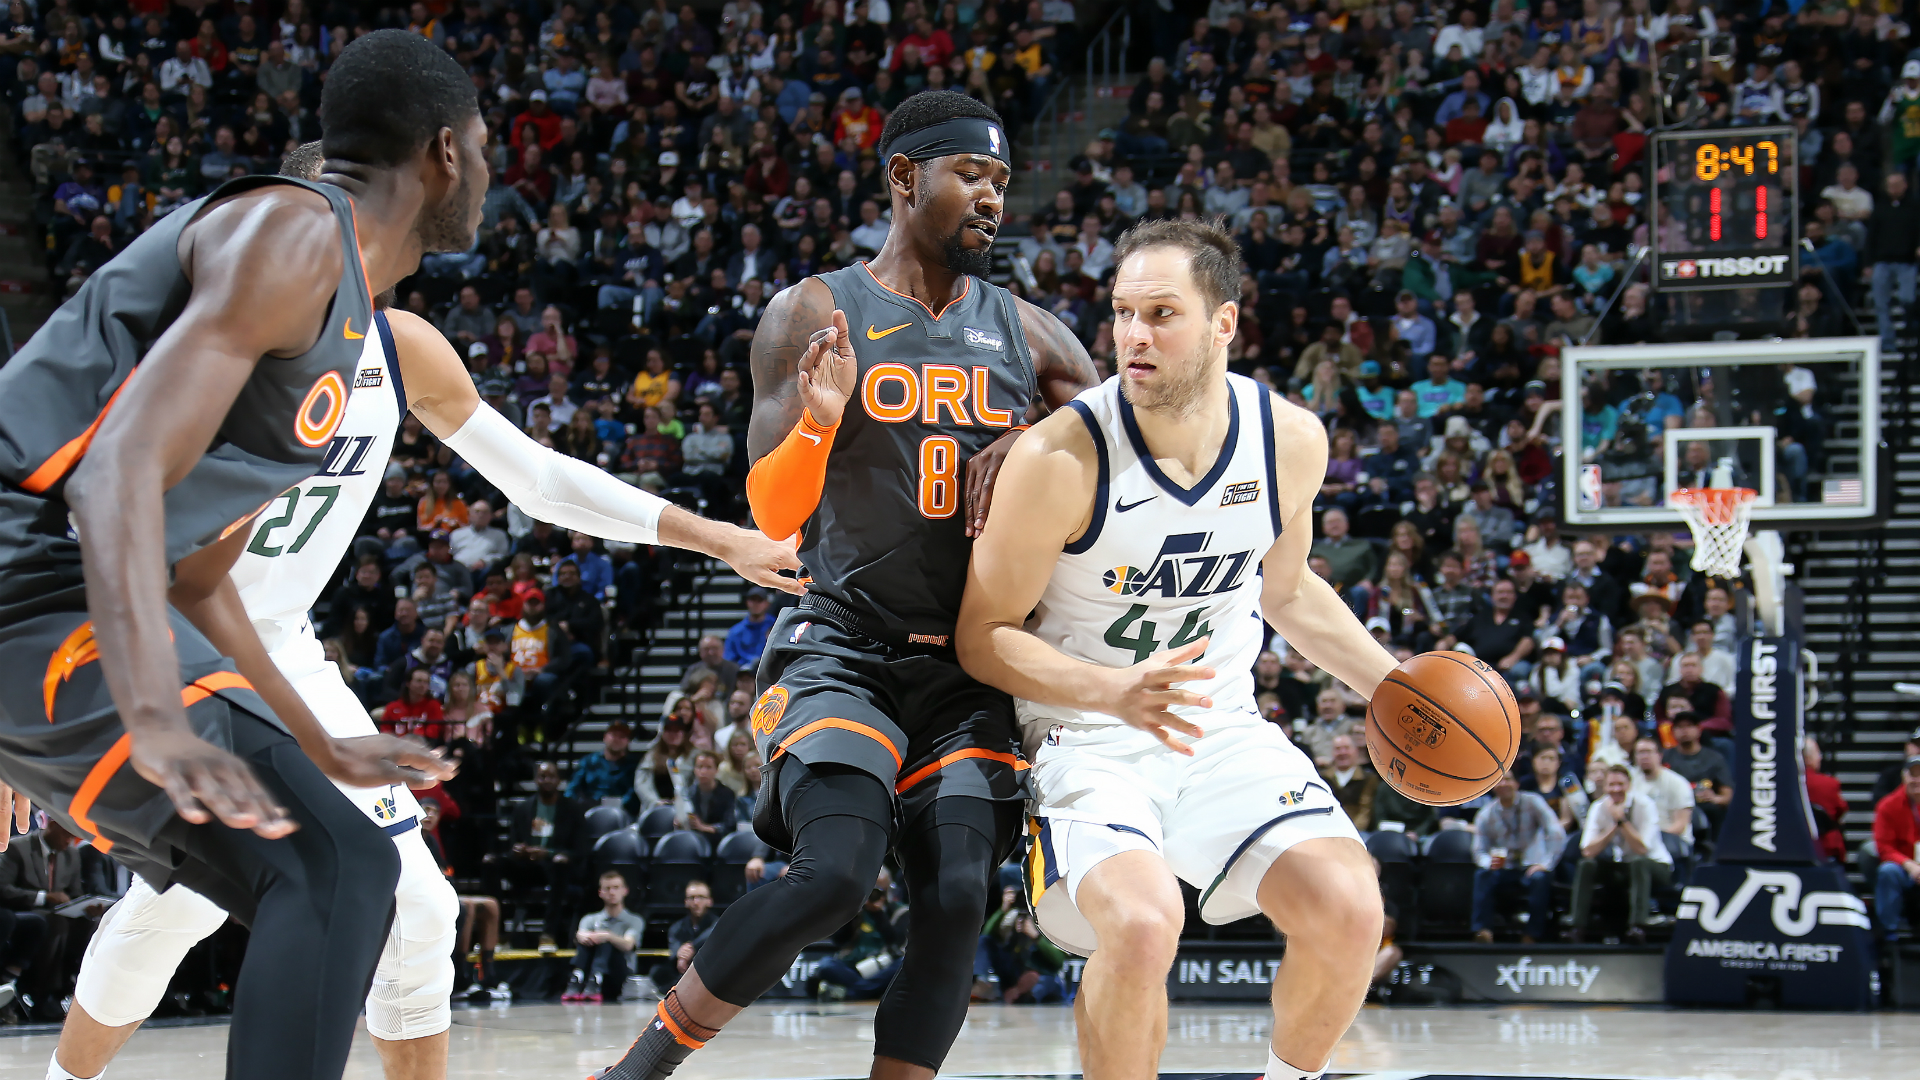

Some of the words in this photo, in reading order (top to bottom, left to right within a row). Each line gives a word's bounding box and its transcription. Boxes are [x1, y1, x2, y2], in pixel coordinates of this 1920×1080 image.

[1696, 140, 1778, 181] 8:47
[1697, 255, 1789, 278] TISSOT
[963, 327, 1003, 351] Disney
[861, 362, 1012, 428] ORL
[918, 434, 960, 519] 8
[1222, 486, 1236, 505] 5
[1233, 490, 1258, 503] FIGHT
[247, 485, 342, 557] 27
[1102, 531, 1255, 599] JAZZ
[1103, 603, 1215, 665] 44
[1751, 638, 1778, 720] FIRST
[1751, 721, 1777, 853] AMERICA
[1685, 938, 1780, 961] AMERICA
[1780, 942, 1843, 963] FIRST
[1720, 959, 1764, 970] CREDIT
[1179, 960, 1211, 984] IN
[1217, 960, 1281, 984] SALT
[1496, 955, 1600, 994] xfinity
